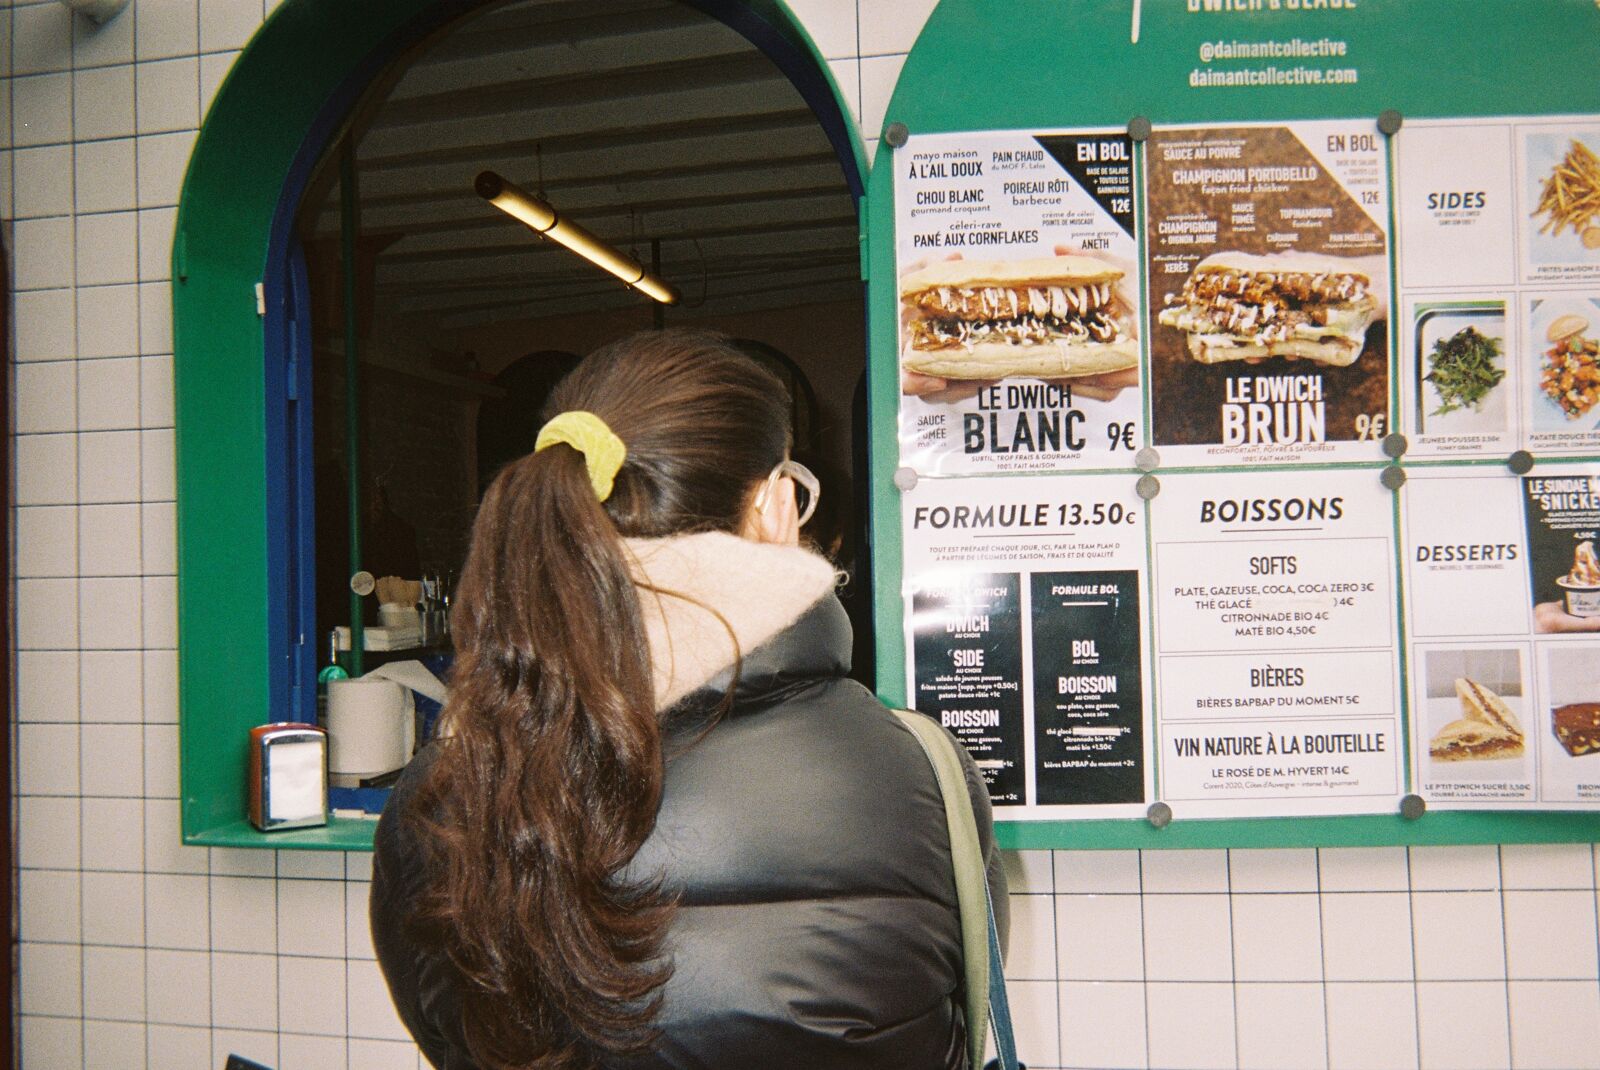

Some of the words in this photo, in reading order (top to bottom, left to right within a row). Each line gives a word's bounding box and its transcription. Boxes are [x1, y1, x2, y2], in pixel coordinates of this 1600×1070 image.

[1200, 39, 1346, 62] @daimantcollective
[1189, 67, 1357, 87] daimantcollective.com
[1327, 135, 1345, 152] EN
[1351, 135, 1378, 151] BOL
[913, 152, 940, 162] mayo
[943, 149, 978, 158] maison
[992, 152, 1012, 162] PAIN
[1015, 150, 1044, 161] CHAUD
[1077, 143, 1097, 162] EN
[1100, 142, 1130, 161] BOL
[1164, 148, 1193, 162] SAUCE
[1195, 148, 1206, 160] AU
[1208, 146, 1241, 159] POIVRE
[909, 162, 916, 179] À
[921, 163, 948, 178] L'AIL
[952, 162, 982, 176] DOUX
[1173, 167, 1245, 185] CHAMPIGNON
[1248, 166, 1317, 182] PORTOBELLO
[1004, 182, 1044, 194] POIREAU
[1048, 178, 1069, 193] RÔTI
[1201, 185, 1226, 196] façon
[1229, 184, 1252, 193] fried
[1253, 184, 1290, 193] chicken
[916, 191, 945, 205] CHOU
[949, 190, 984, 204] BLANC
[1012, 196, 1062, 206] barbecue
[1362, 191, 1379, 204] 12€
[1428, 192, 1486, 209] SIDES
[911, 206, 952, 216] gourmand
[954, 205, 990, 215] croquant
[1111, 199, 1130, 214] 12€
[1232, 204, 1254, 213] SAUCE
[950, 220, 1002, 230] céleri-rave
[1159, 221, 1218, 234] CHAMPIGNON
[914, 231, 941, 248] PANÉ
[945, 232, 965, 246] AUX
[968, 230, 1038, 246] CORNFLAKES
[1082, 239, 1109, 250] ANETH
[978, 386, 1001, 410] LE
[1007, 384, 1071, 409] DWICH
[1226, 377, 1251, 403] LE
[1256, 375, 1322, 402] DWICH
[917, 415, 945, 425] SAUCE
[1222, 402, 1326, 446] BRUN
[917, 428, 946, 439] UMÉE
[964, 410, 1086, 454] BLANC
[1107, 422, 1136, 451] 9€
[1355, 414, 1385, 444] 9€
[1529, 480, 1543, 493] LE
[1545, 479, 1588, 493] SUNDAE
[914, 504, 1050, 529] FORMULE
[1058, 503, 1136, 526] 13.50€
[1200, 497, 1344, 523] BOISSONS
[1416, 544, 1518, 562] DESSERTS
[1250, 556, 1297, 575] SOFTS
[1052, 585, 1098, 595] FORMULE
[1100, 585, 1119, 594] BOL
[1175, 587, 1208, 596] PLATE,
[1211, 586, 1260, 596] GAZEUSE,
[1262, 586, 1296, 595] COCA,
[1298, 584, 1328, 593] COCA
[1330, 583, 1359, 593] ZERO
[1361, 583, 1374, 592] 3€
[1195, 598, 1215, 610] THÉ
[1218, 598, 1252, 609] GLACÉ
[946, 616, 990, 632] DWICH
[1221, 612, 1292, 623] CITRONNADE
[1294, 612, 1312, 621] BIO
[1315, 611, 1329, 620] 4€
[1235, 626, 1263, 637] MATÉ
[1266, 627, 1284, 636] BIO
[1072, 641, 1099, 657] BOL
[954, 649, 984, 667] SIDE
[1250, 664, 1304, 688] BIÈRES
[1058, 675, 1117, 694] BOISSON
[1197, 698, 1232, 708] BIÈRES
[1235, 698, 1275, 707] BAPBAP
[1278, 697, 1293, 706] DU
[1296, 696, 1344, 706] MOMENT
[1346, 695, 1360, 704] 5€
[942, 709, 999, 727] BOISSON
[1174, 738, 1200, 757] VIN
[1205, 736, 1262, 757] NATURE
[1267, 732, 1277, 755] À
[1281, 736, 1300, 754] LA
[1305, 733, 1384, 754] BOUTEILLE
[1212, 768, 1224, 778] LE
[1226, 766, 1254, 777] ROSÉ
[1257, 767, 1271, 777] DE
[1273, 767, 1285, 776] M.
[1288, 766, 1328, 776] HYVERT
[1331, 766, 1349, 775] 14€
